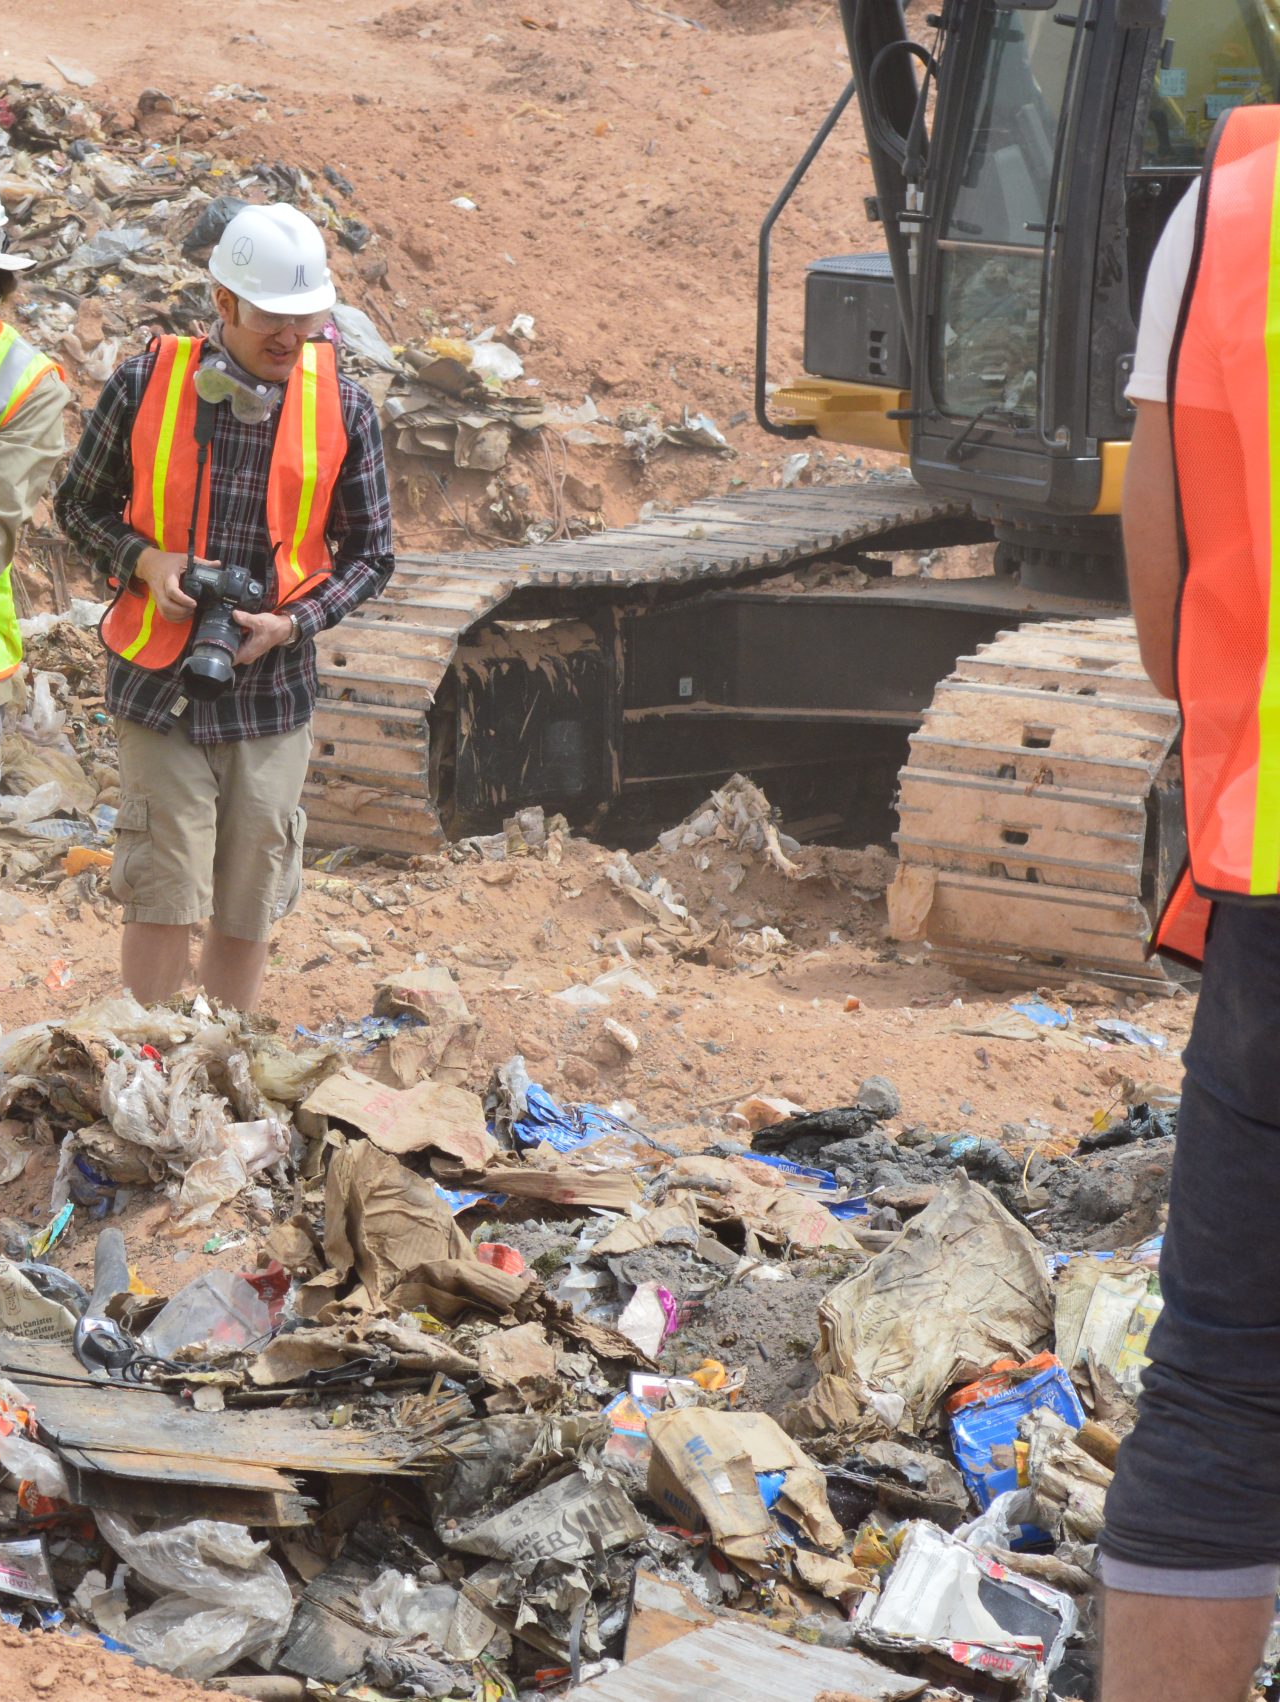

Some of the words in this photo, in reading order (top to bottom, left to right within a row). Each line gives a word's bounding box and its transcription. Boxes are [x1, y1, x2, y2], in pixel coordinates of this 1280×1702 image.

[777, 1164, 797, 1174] ATARI
[22, 1316, 53, 1329] Canister
[23, 1325, 55, 1337] Canister
[993, 1387, 1018, 1400] ATARI
[978, 1652, 1015, 1673] ATARI
